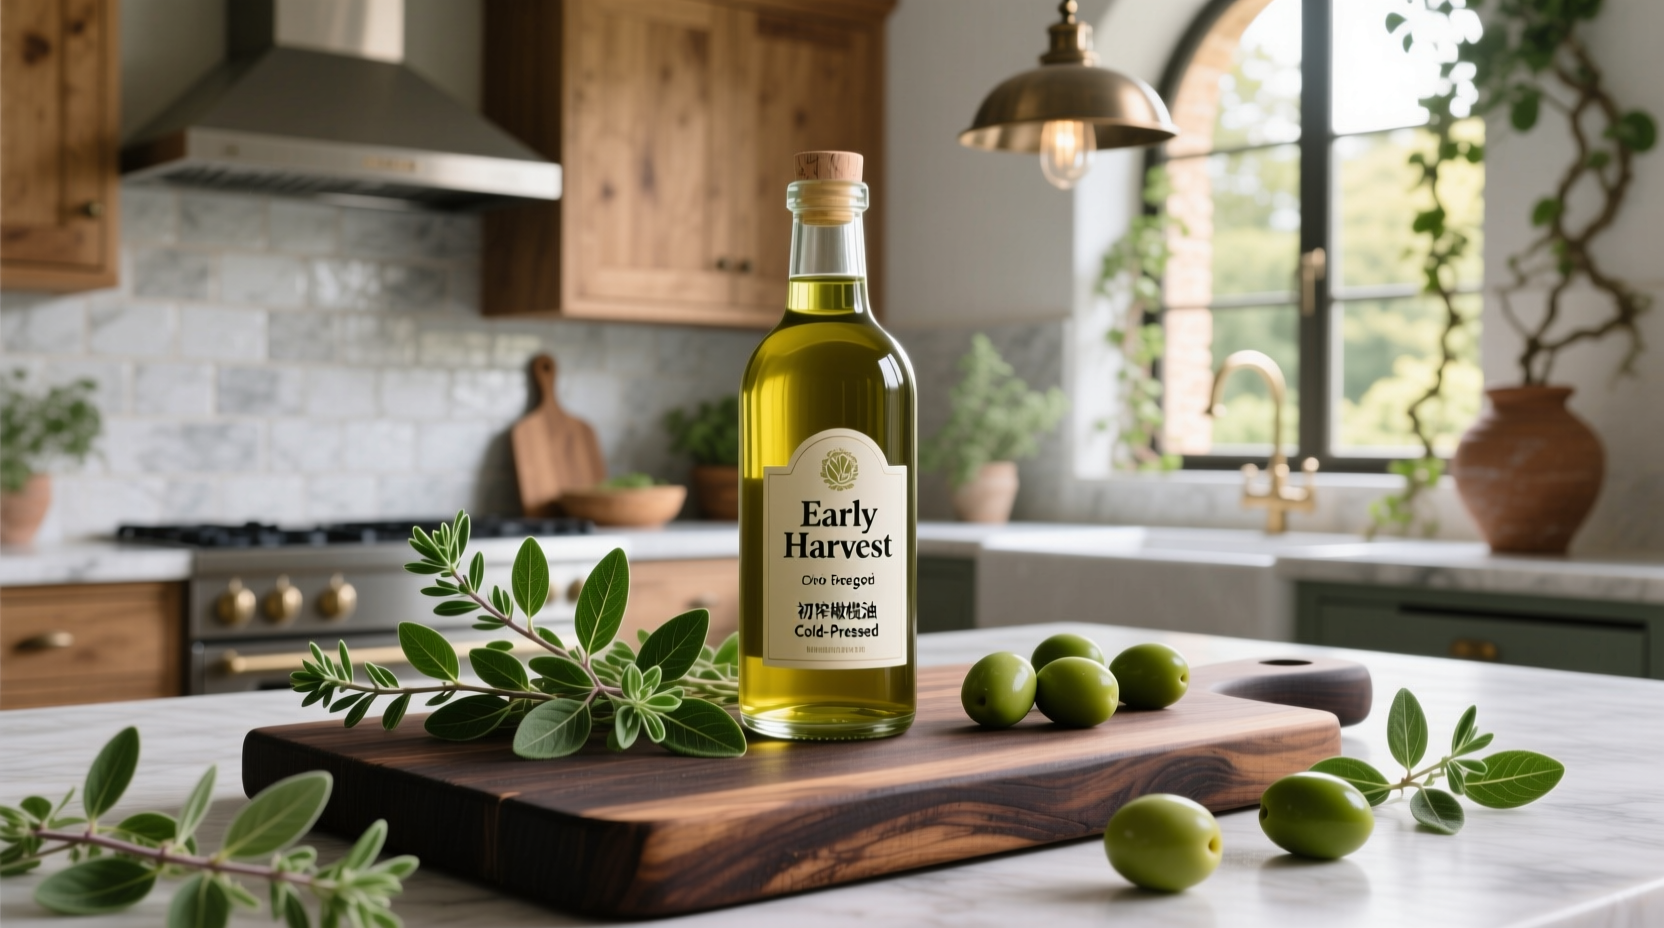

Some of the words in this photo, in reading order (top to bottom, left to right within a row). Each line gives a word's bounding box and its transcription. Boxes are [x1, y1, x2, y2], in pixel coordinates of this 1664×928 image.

[800, 499, 878, 533] Early
[783, 532, 892, 559] Harvest
[794, 623, 879, 638] Cold-Pressed
